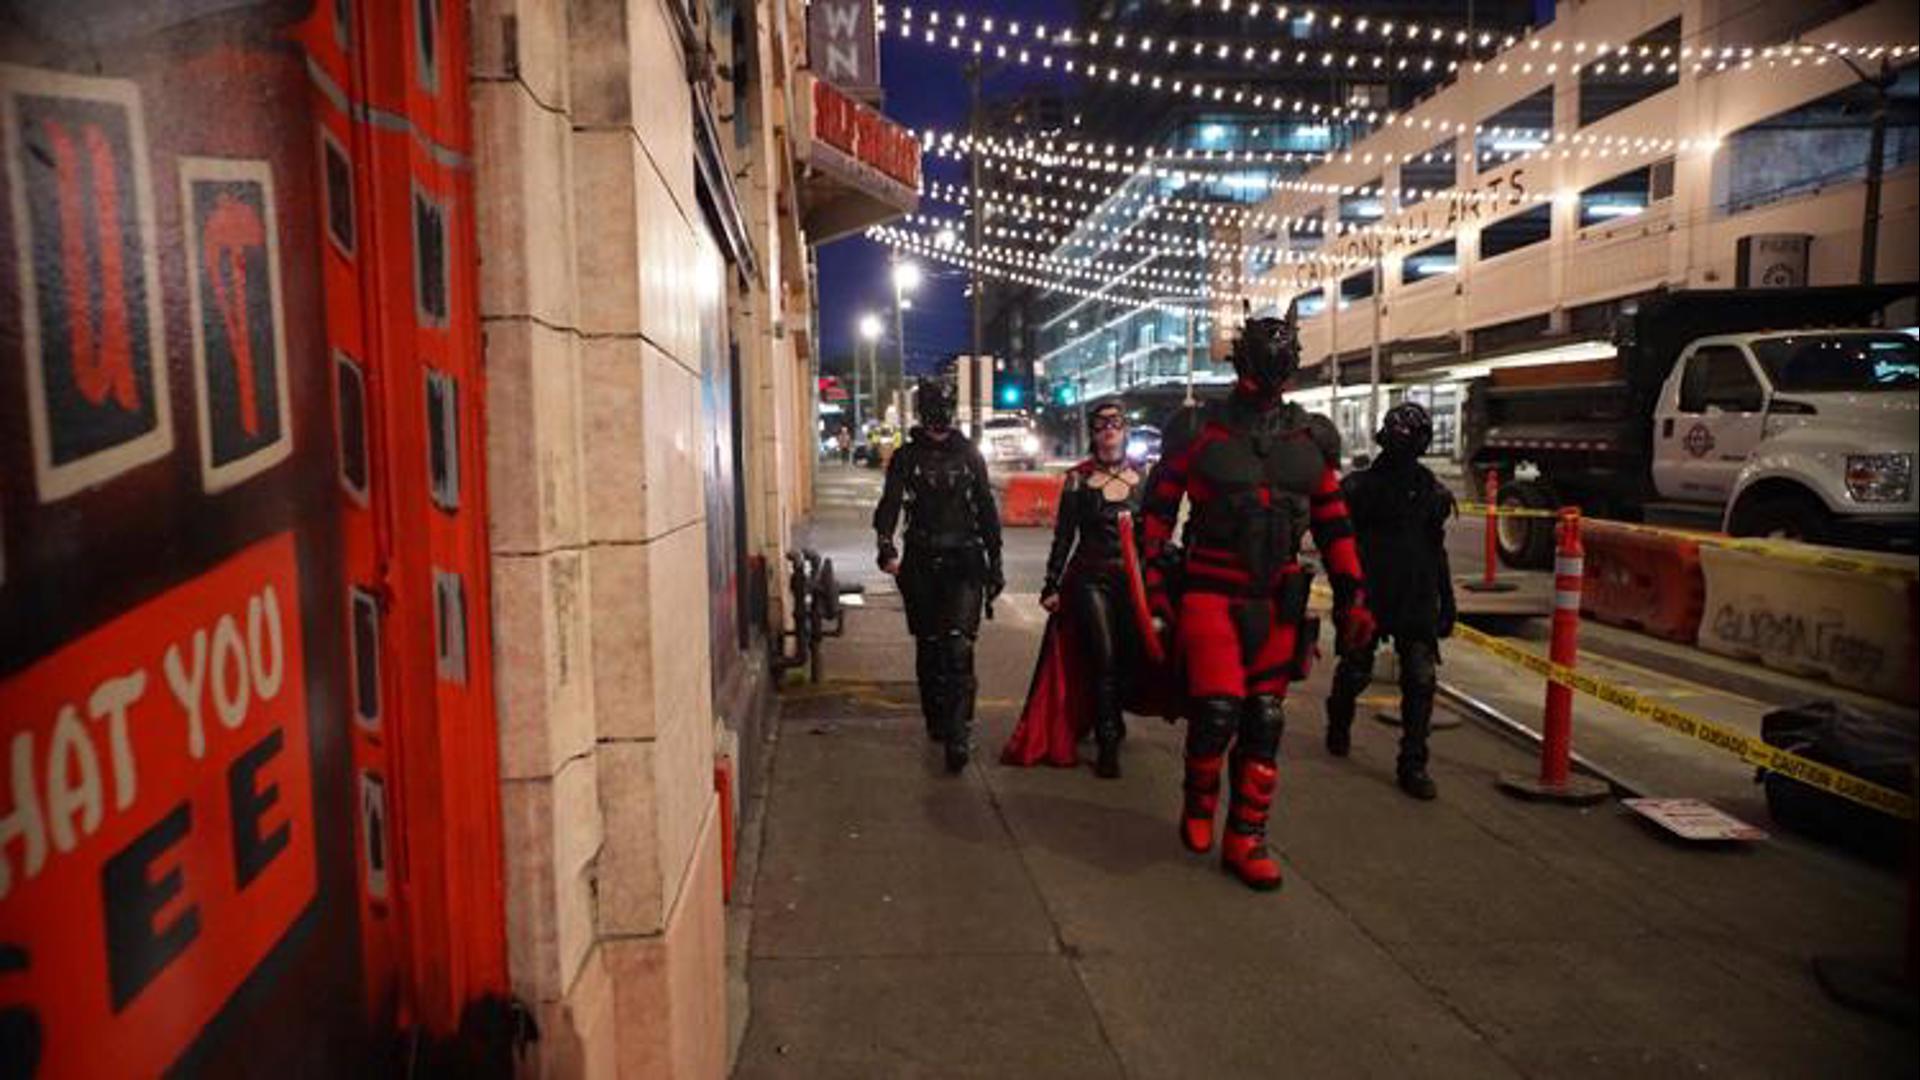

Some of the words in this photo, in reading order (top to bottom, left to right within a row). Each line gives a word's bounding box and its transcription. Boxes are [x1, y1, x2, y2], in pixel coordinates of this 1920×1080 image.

[1447, 169, 1524, 230] ARTS
[163, 585, 284, 759] YOU
[1652, 706, 1696, 737] CAUTION
[1699, 725, 1748, 756] CUIDADO
[1770, 752, 1833, 786] CAUTION
